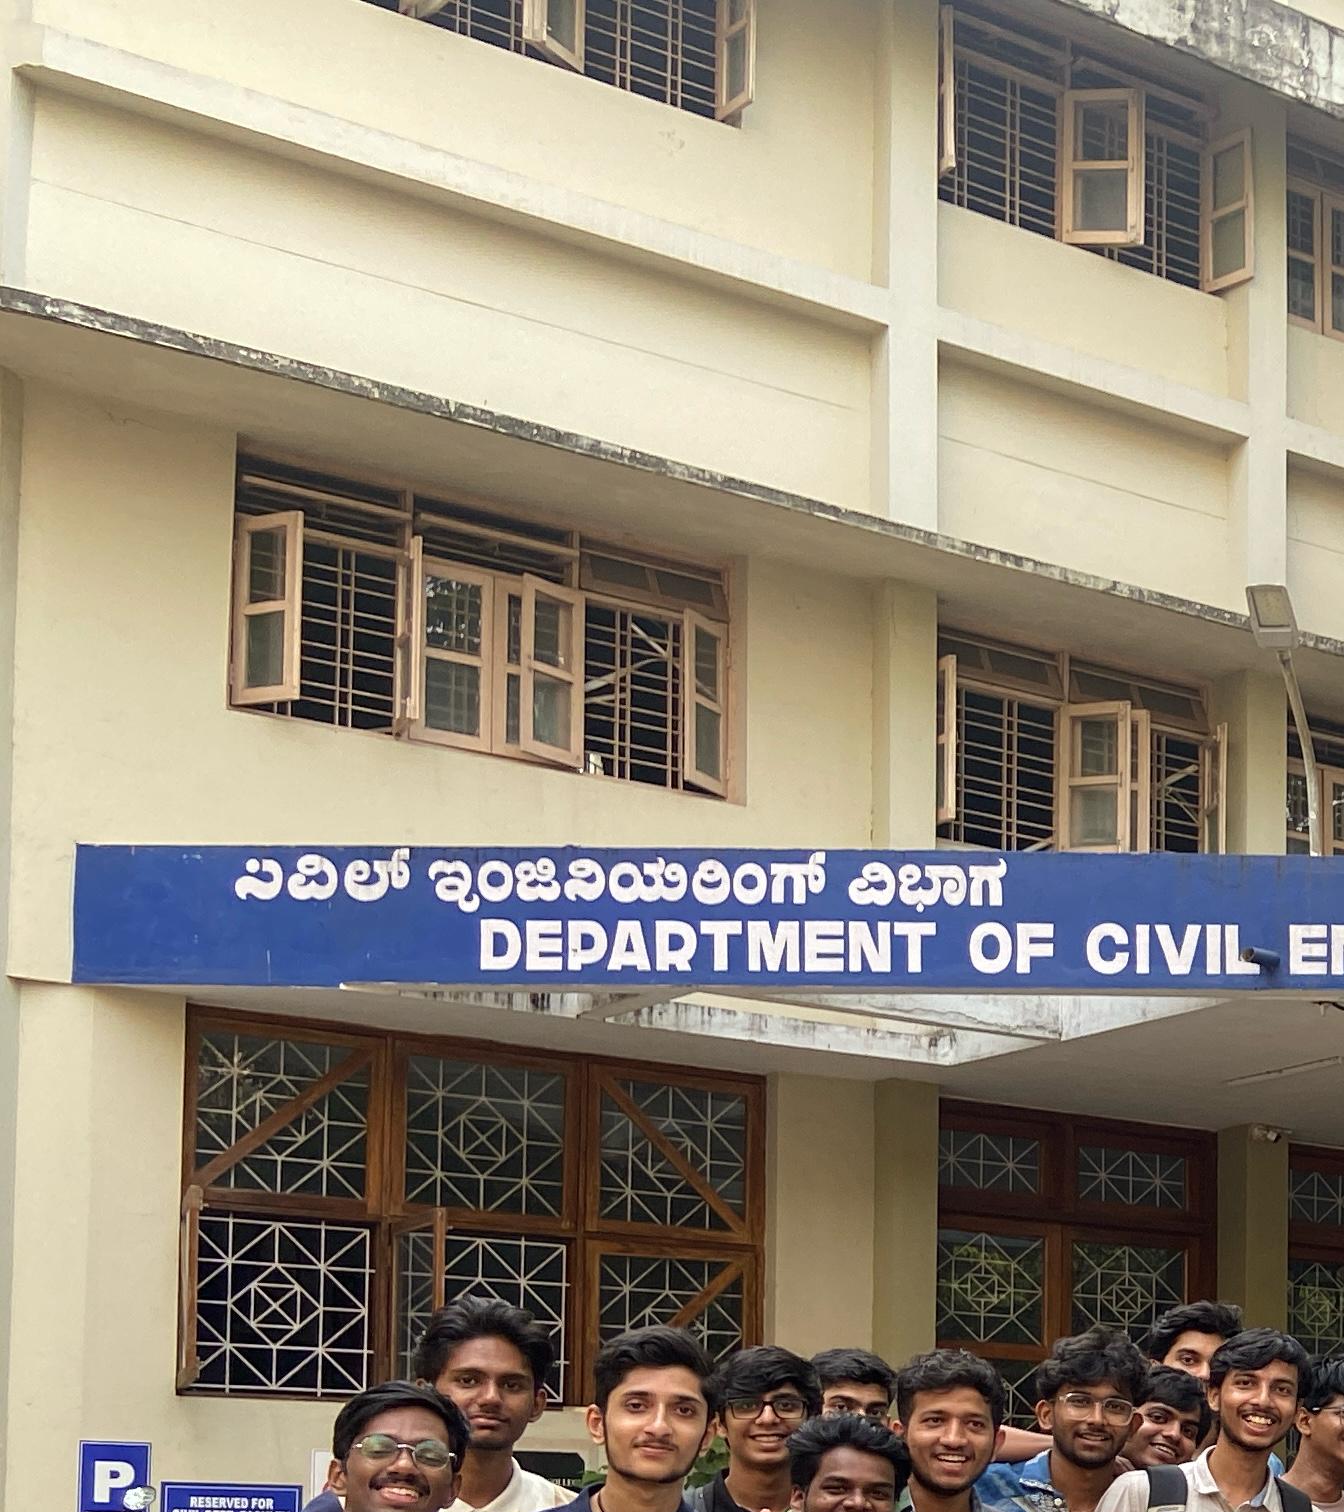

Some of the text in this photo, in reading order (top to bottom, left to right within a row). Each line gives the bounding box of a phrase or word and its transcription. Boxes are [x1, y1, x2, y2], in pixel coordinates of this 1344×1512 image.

[234, 847, 411, 902] ಸಿವಿಲ್
[848, 857, 1008, 912] ವಿಭಾಗ
[479, 919, 937, 973] DEPARTMENT
[969, 922, 1054, 975] OF
[1086, 922, 1260, 976] CIVIL
[93, 1460, 136, 1503] P
[189, 1496, 274, 1510] RESERVED FOR
